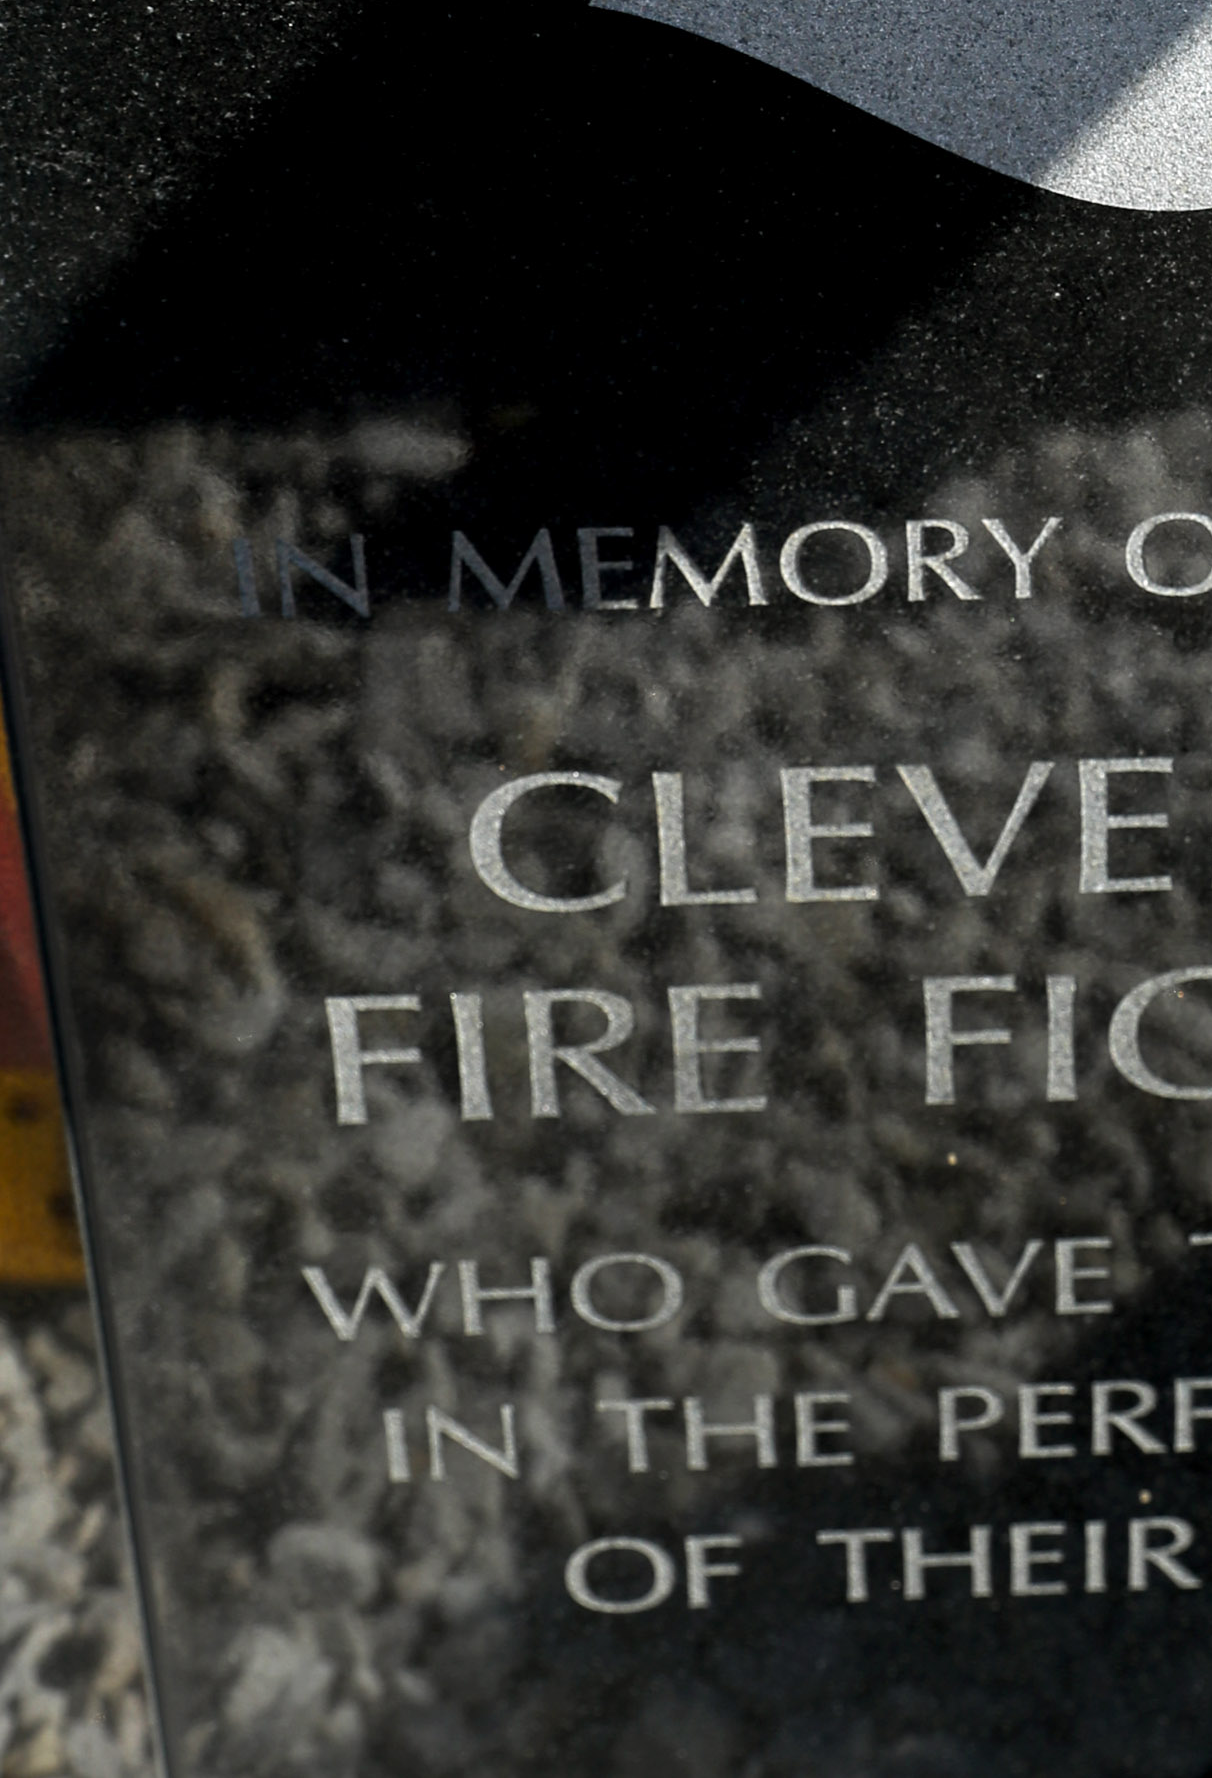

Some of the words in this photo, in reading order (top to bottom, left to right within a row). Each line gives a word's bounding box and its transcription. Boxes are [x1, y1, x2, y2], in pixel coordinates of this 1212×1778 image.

[232, 533, 371, 618] IN
[447, 516, 1062, 612] MEMORY
[324, 983, 768, 1125] FIRE
[300, 1252, 684, 1341] WHO
[757, 1237, 1113, 1325] GAVE
[382, 1404, 519, 1482] IN
[596, 1392, 854, 1473] THE
[564, 1533, 743, 1614] OF
[816, 1516, 1201, 1602] THEIR
